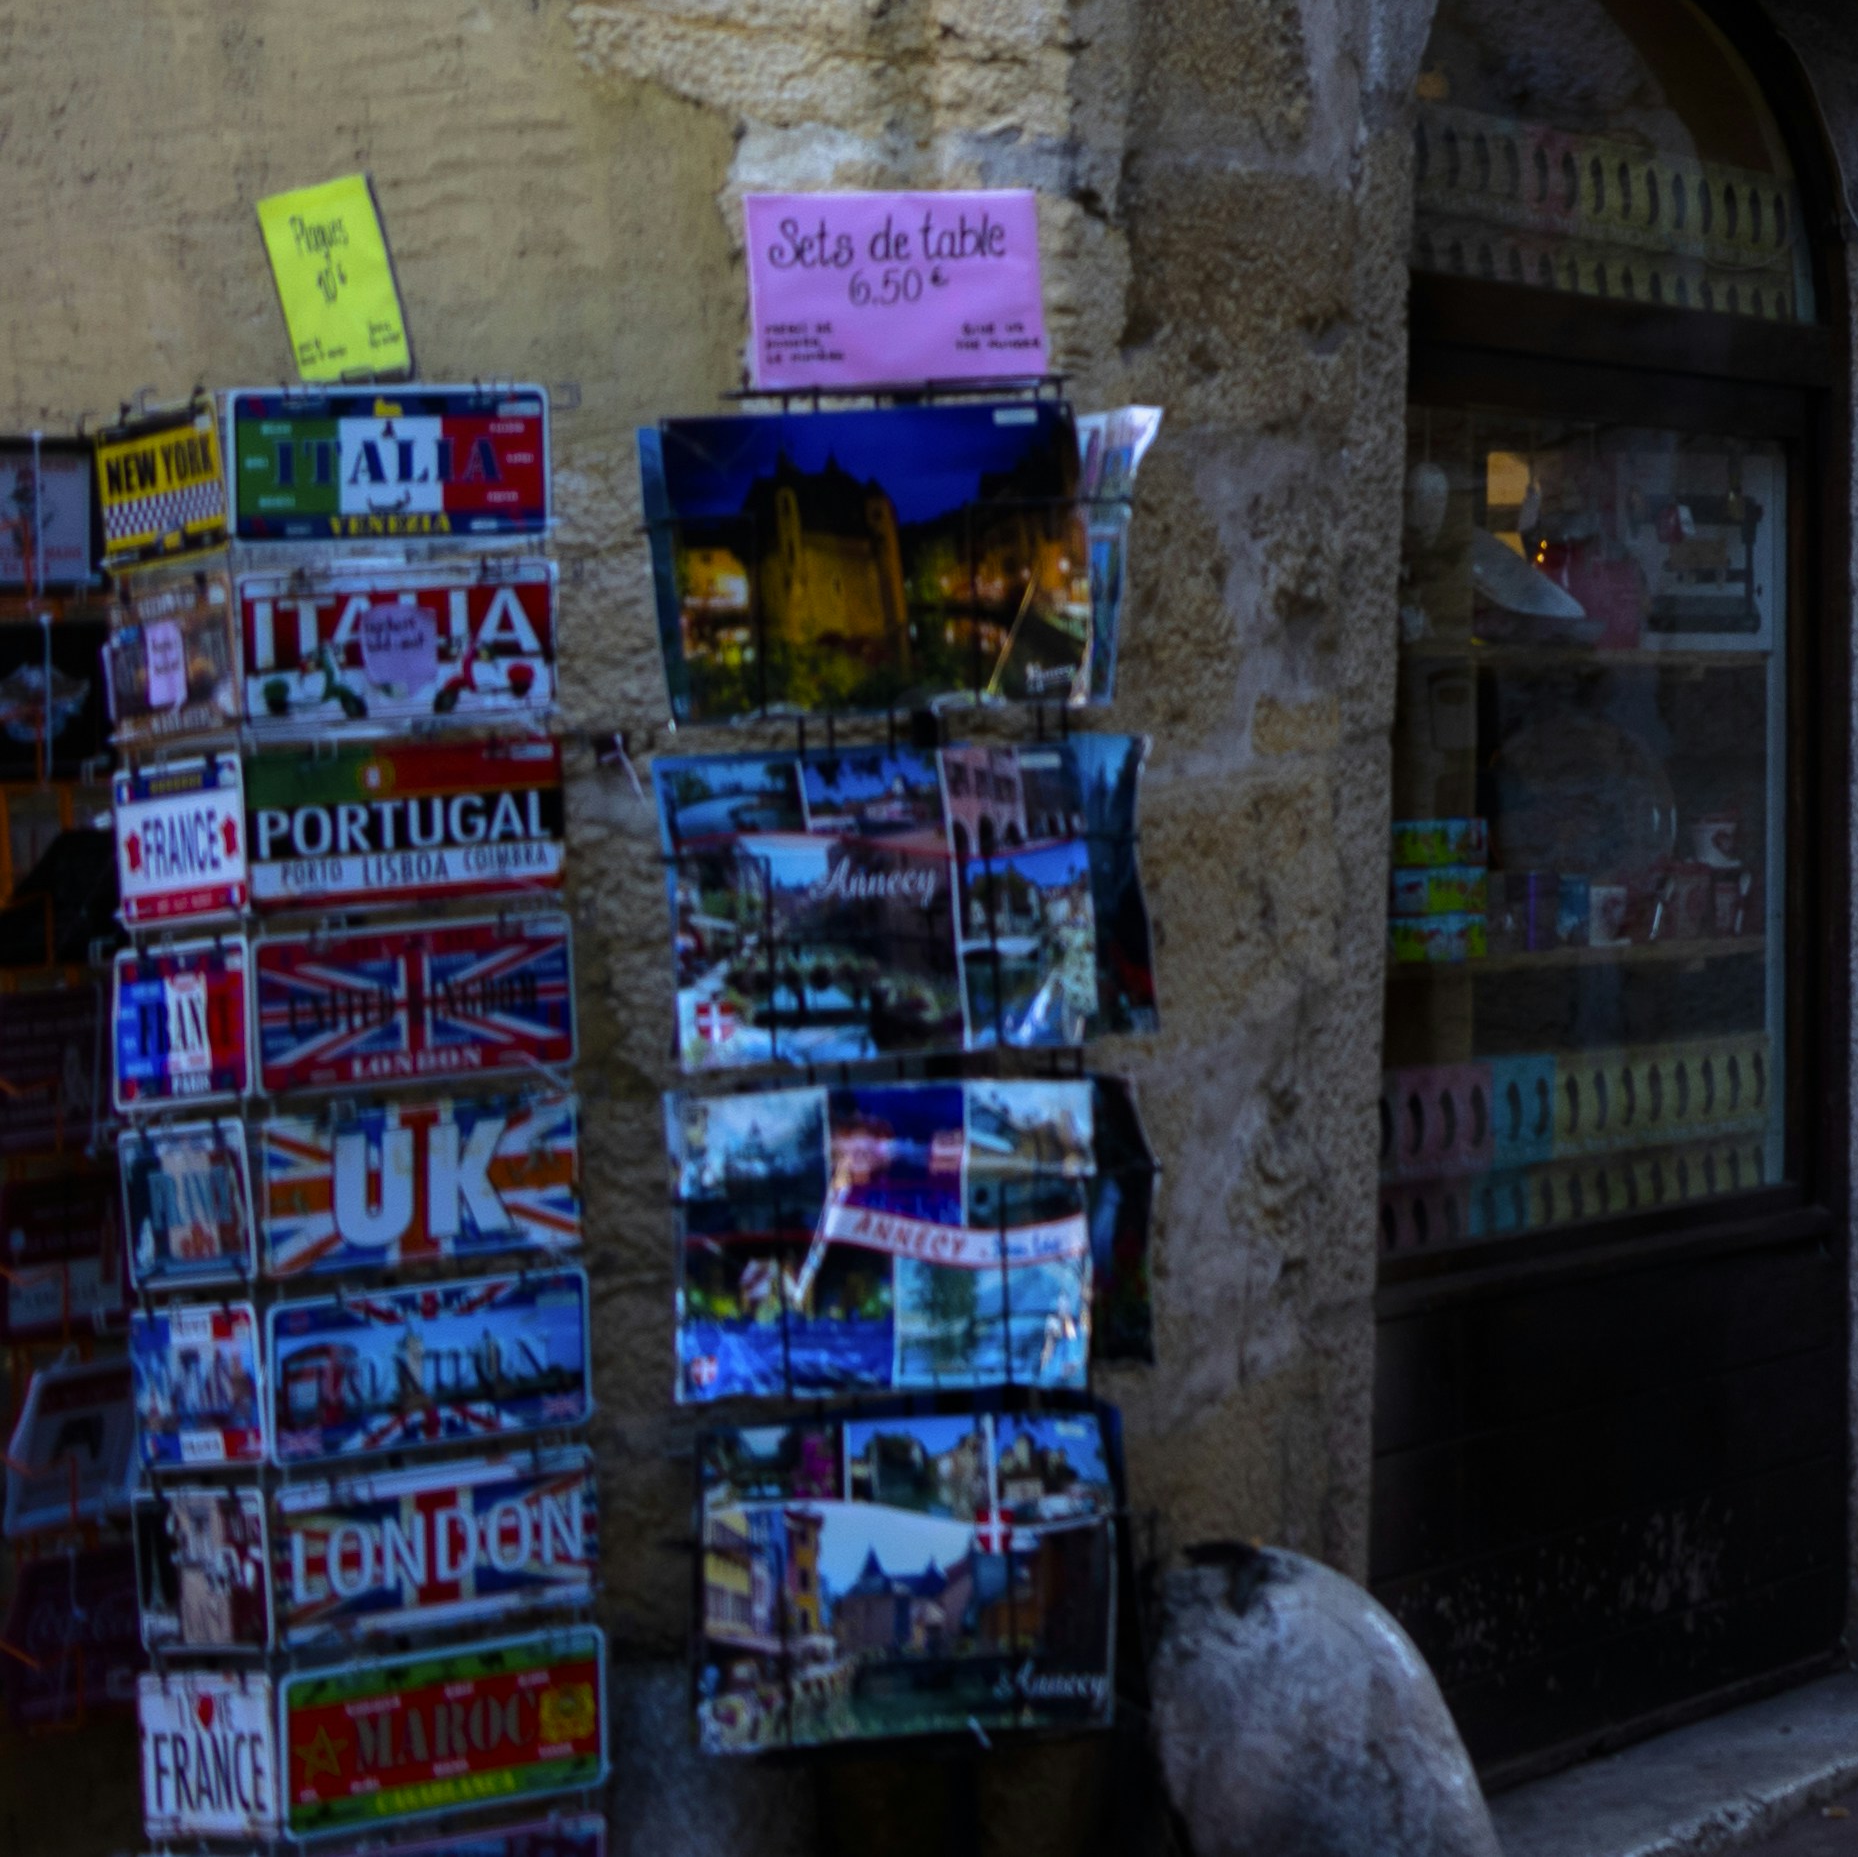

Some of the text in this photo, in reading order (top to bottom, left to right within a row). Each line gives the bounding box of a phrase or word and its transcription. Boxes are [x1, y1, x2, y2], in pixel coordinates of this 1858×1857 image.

[768, 209, 1007, 269] Sets de table
[105, 449, 157, 496] NEW
[159, 433, 215, 486] YORK
[275, 436, 503, 488] ITALIA
[329, 510, 453, 537] VENEZIA
[250, 586, 545, 670] ITAIA
[141, 809, 223, 880] FRANCE
[256, 788, 553, 860] PORTUGAL
[280, 841, 549, 888] PORTO LISBOA COIMBRA
[808, 853, 937, 911] Annecy
[352, 1046, 484, 1080] LONDON
[335, 1118, 522, 1248] UK
[291, 1492, 584, 1606] LONDON
[354, 1690, 537, 1774] MAROC
[153, 1732, 267, 1812] FRANCE
